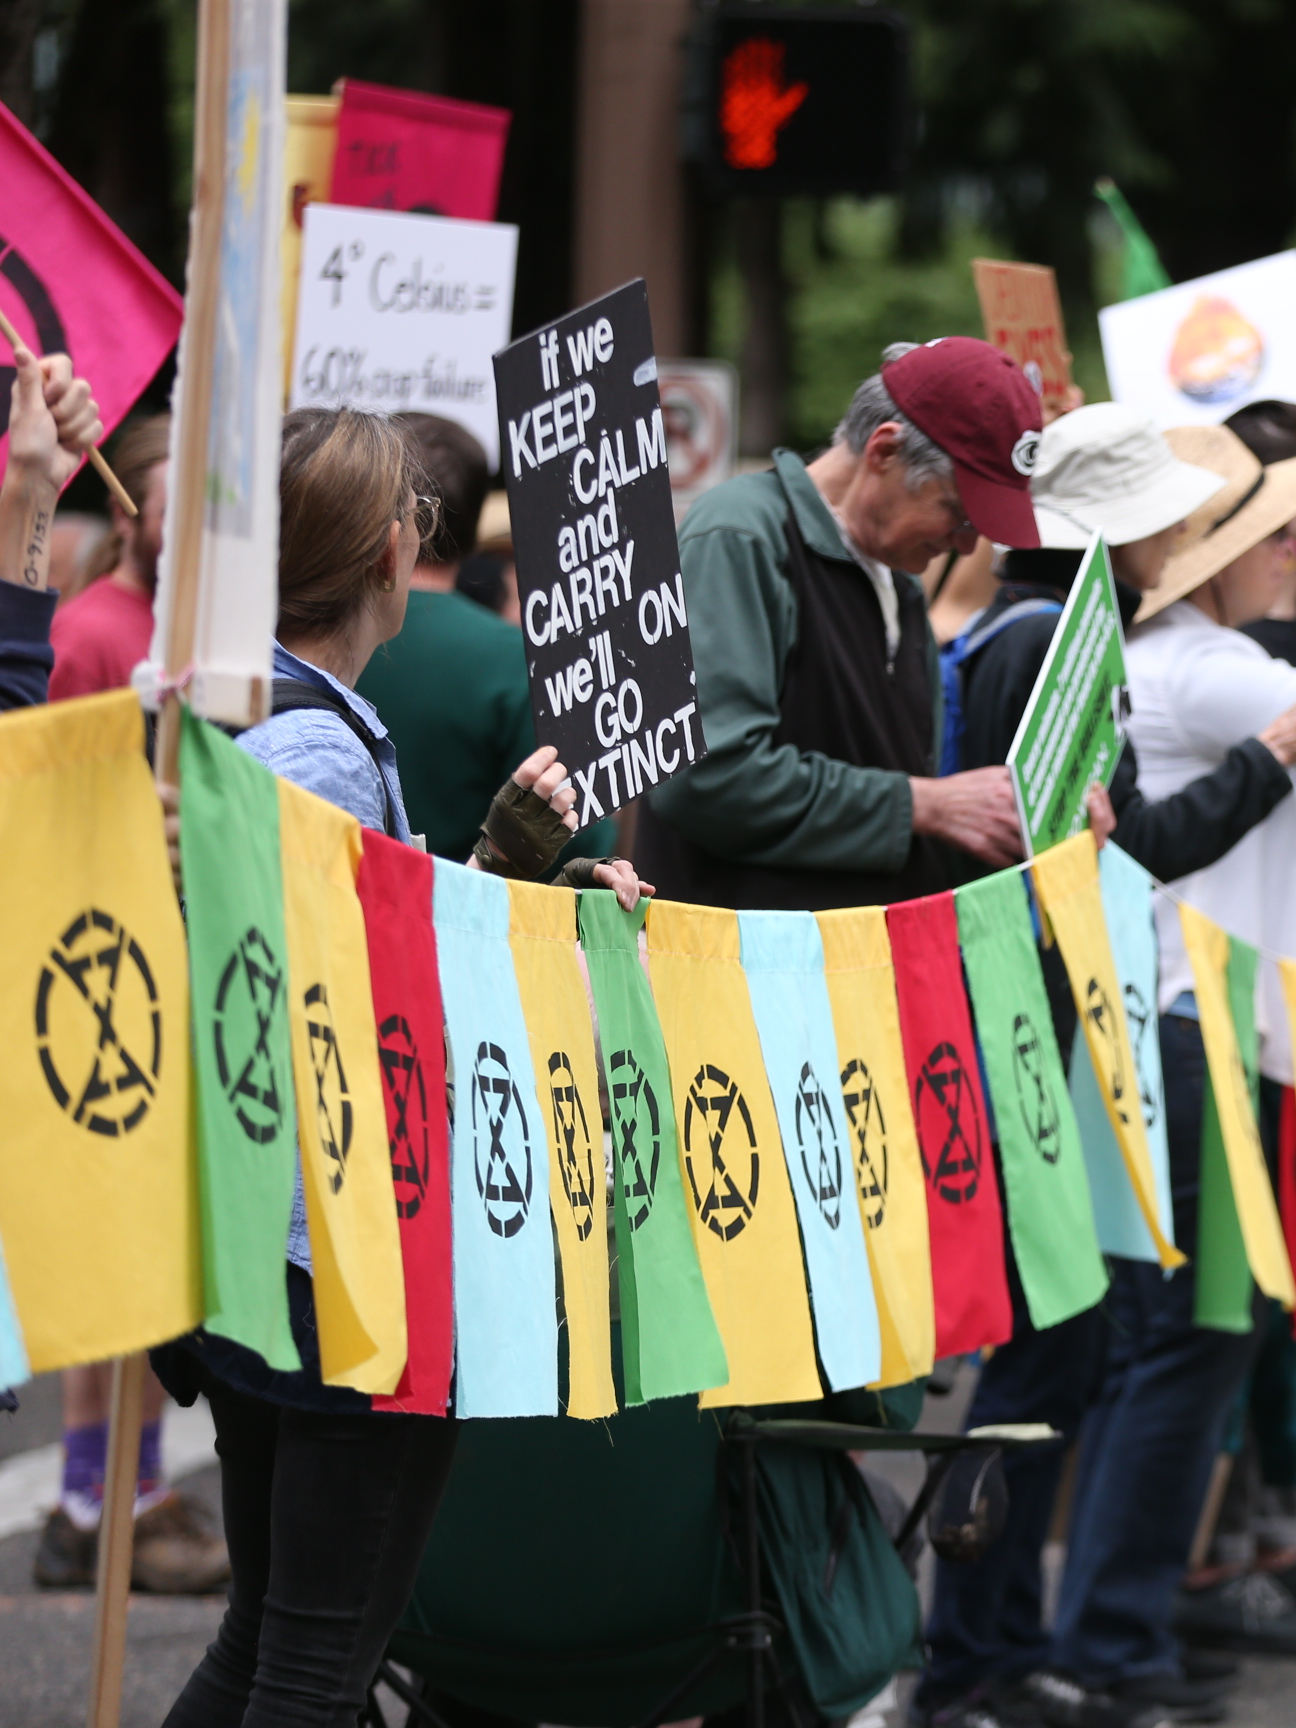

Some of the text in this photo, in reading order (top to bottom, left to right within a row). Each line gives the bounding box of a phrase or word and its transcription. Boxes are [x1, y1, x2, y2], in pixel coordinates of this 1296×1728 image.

[538, 317, 614, 391] if we
[508, 382, 596, 477] KEEP
[572, 408, 668, 505] CALM
[558, 486, 618, 573] and
[525, 540, 635, 647] CARRY
[638, 573, 687, 645] ON
[544, 630, 617, 717] we'll
[594, 678, 643, 748] GO
